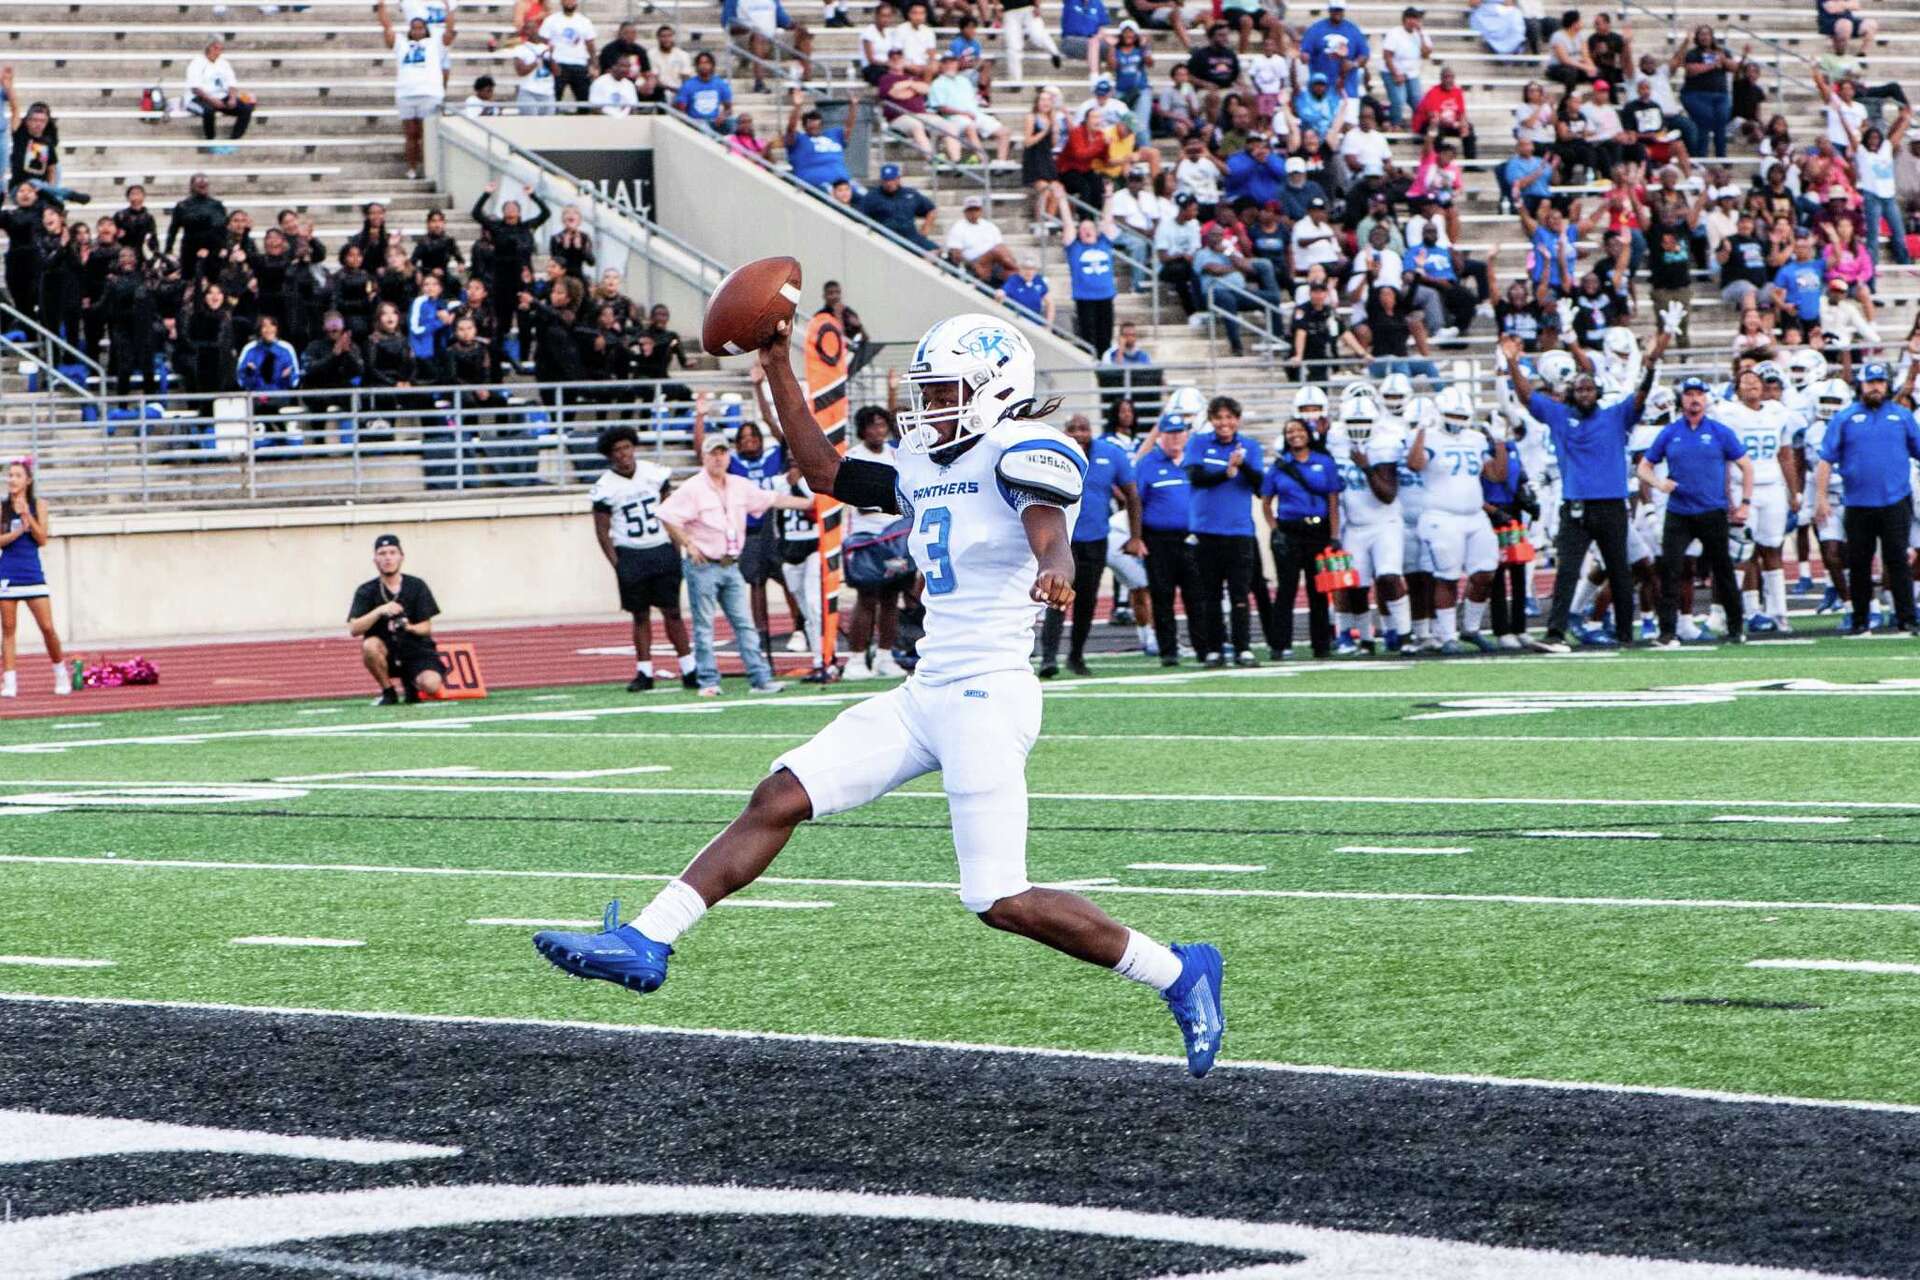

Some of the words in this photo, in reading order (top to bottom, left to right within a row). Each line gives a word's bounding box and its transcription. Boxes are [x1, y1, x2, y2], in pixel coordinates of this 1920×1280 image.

[978, 335, 1004, 356] K
[1445, 451, 1480, 476] 75
[913, 481, 979, 501] PANTHERS
[622, 497, 660, 538] 55
[919, 505, 959, 596] 3
[439, 651, 479, 689] 20
